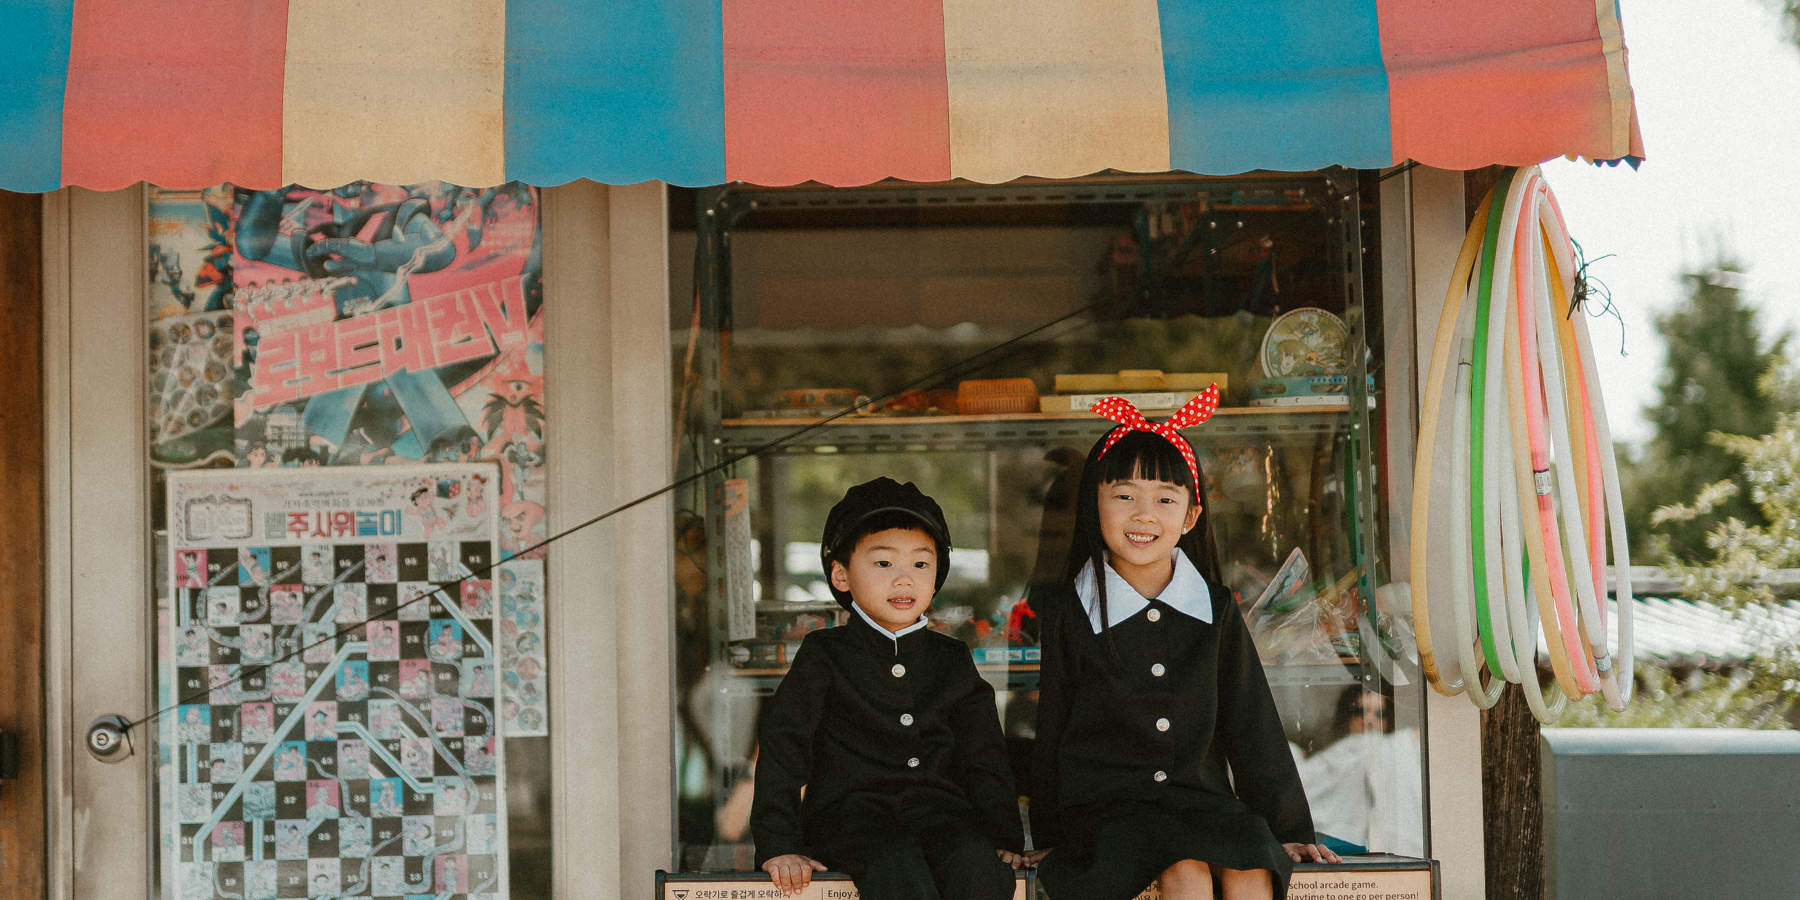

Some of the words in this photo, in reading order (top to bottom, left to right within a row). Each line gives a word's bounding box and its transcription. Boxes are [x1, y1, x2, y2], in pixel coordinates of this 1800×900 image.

[1288, 881, 1318, 890] school
[1320, 881, 1349, 889] arcade
[1351, 881, 1379, 890] game.
[695, 889, 729, 899] 오락기로
[730, 889, 755, 899] 즐겁게
[757, 889, 788, 899] 오락하
[828, 889, 853, 899] Enjoy
[1326, 892, 1336, 900] to
[1385, 891, 1419, 900] person!
